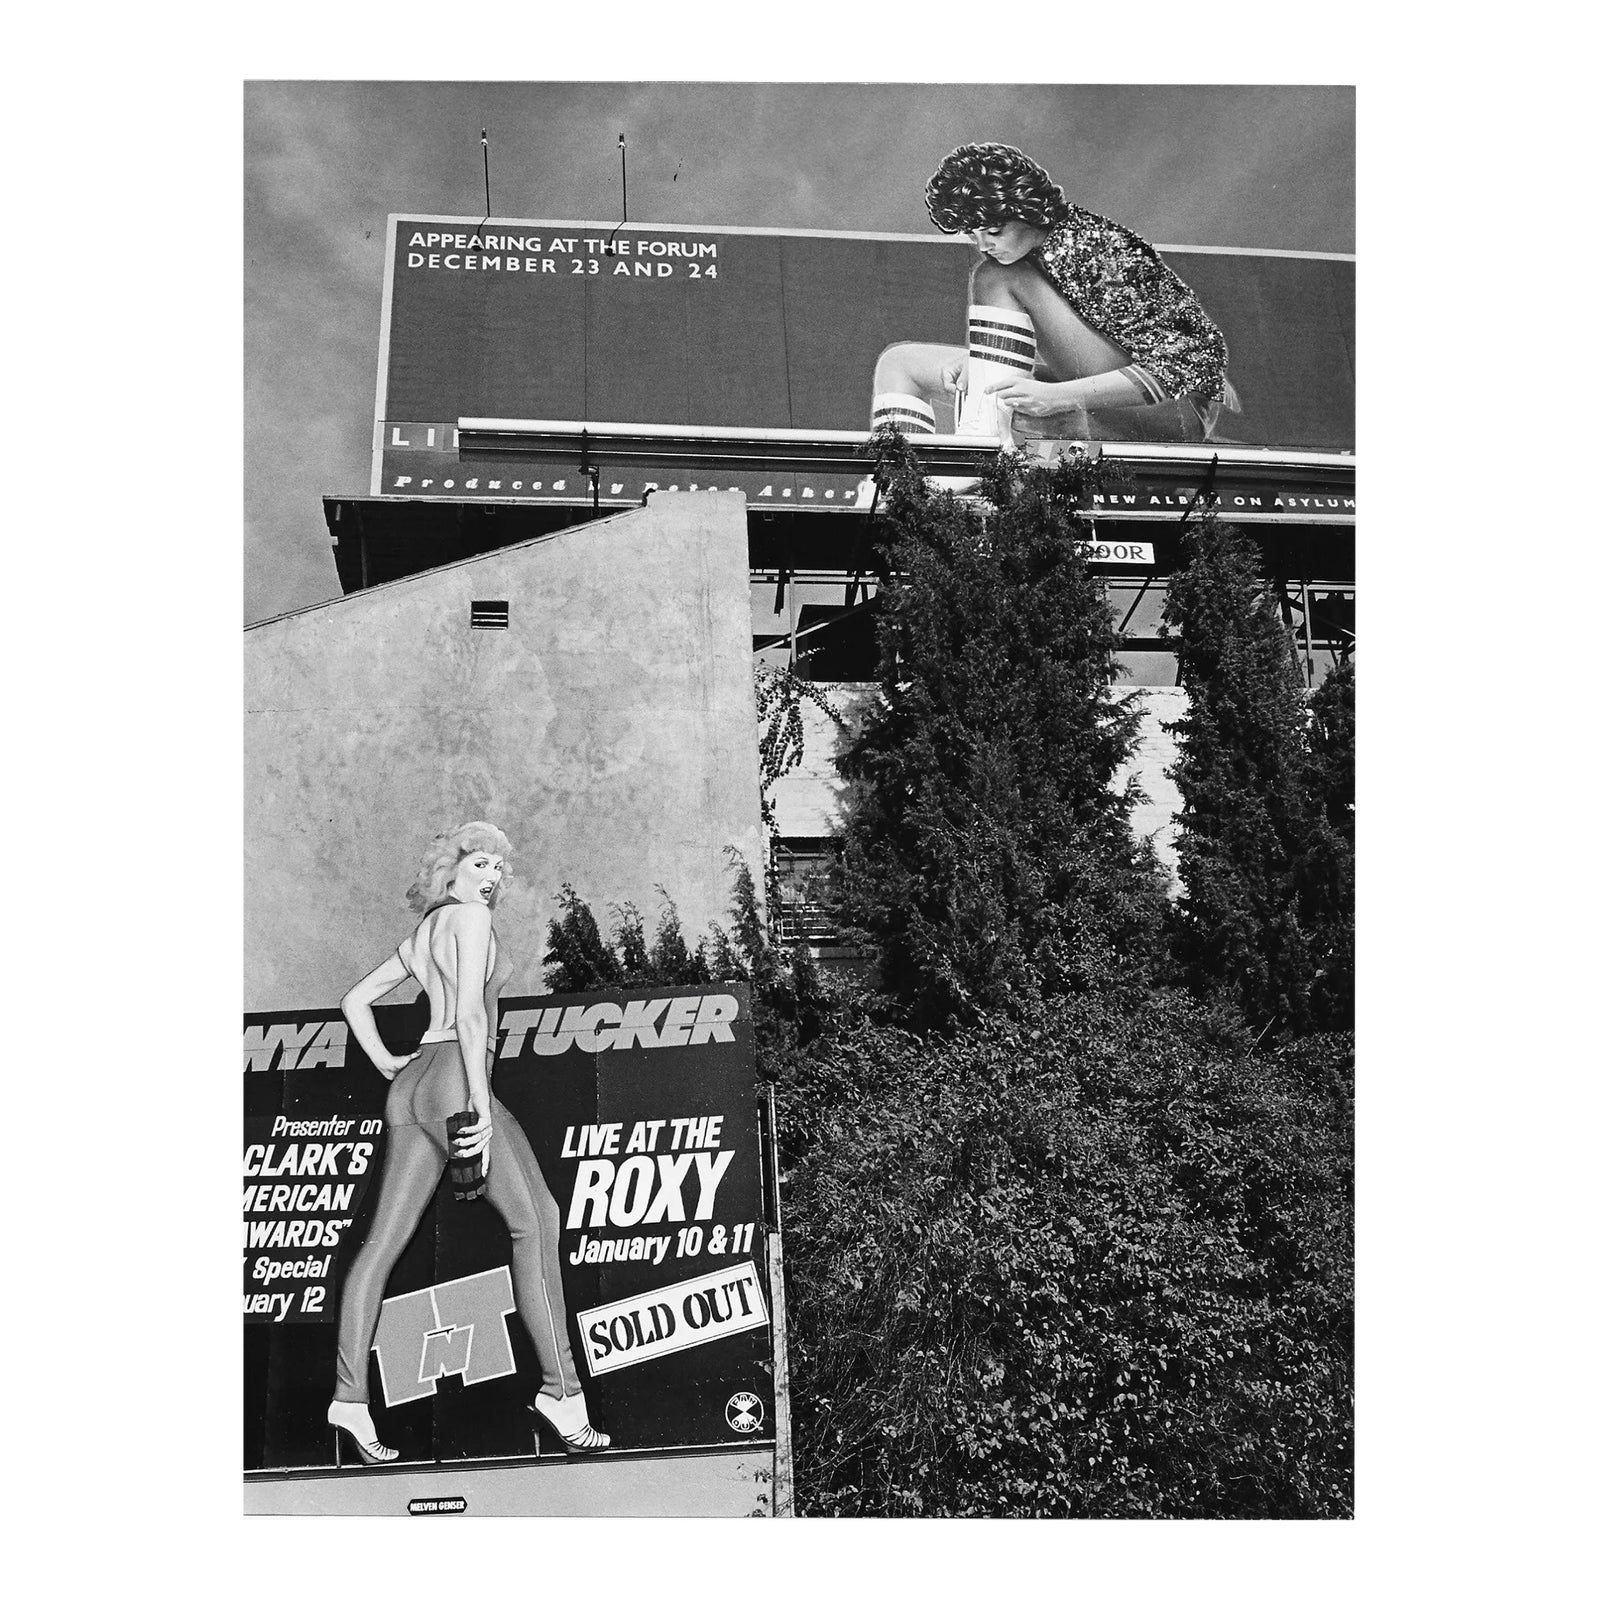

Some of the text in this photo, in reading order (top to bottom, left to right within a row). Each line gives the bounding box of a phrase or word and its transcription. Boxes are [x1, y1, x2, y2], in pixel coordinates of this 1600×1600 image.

[408, 232, 718, 258] APPEARING AT THE FORUM
[407, 252, 718, 279] DECEMBER 23 AND 24
[393, 476, 566, 491] Produced
[1093, 494, 1136, 504] NEW
[1234, 497, 1262, 506] ON
[1274, 498, 1356, 508] ASYLUM
[499, 994, 739, 1059] TUCKER
[271, 1114, 383, 1137] Presenter on
[560, 1115, 724, 1158] LIVE AT THE
[243, 1142, 374, 1177] CLARK'S
[566, 1150, 736, 1230] ROXY
[569, 1223, 755, 1266] January 10 & 11
[253, 1254, 332, 1286] Special
[300, 1286, 326, 1313] 12
[589, 1277, 753, 1360] SOLD OUT
